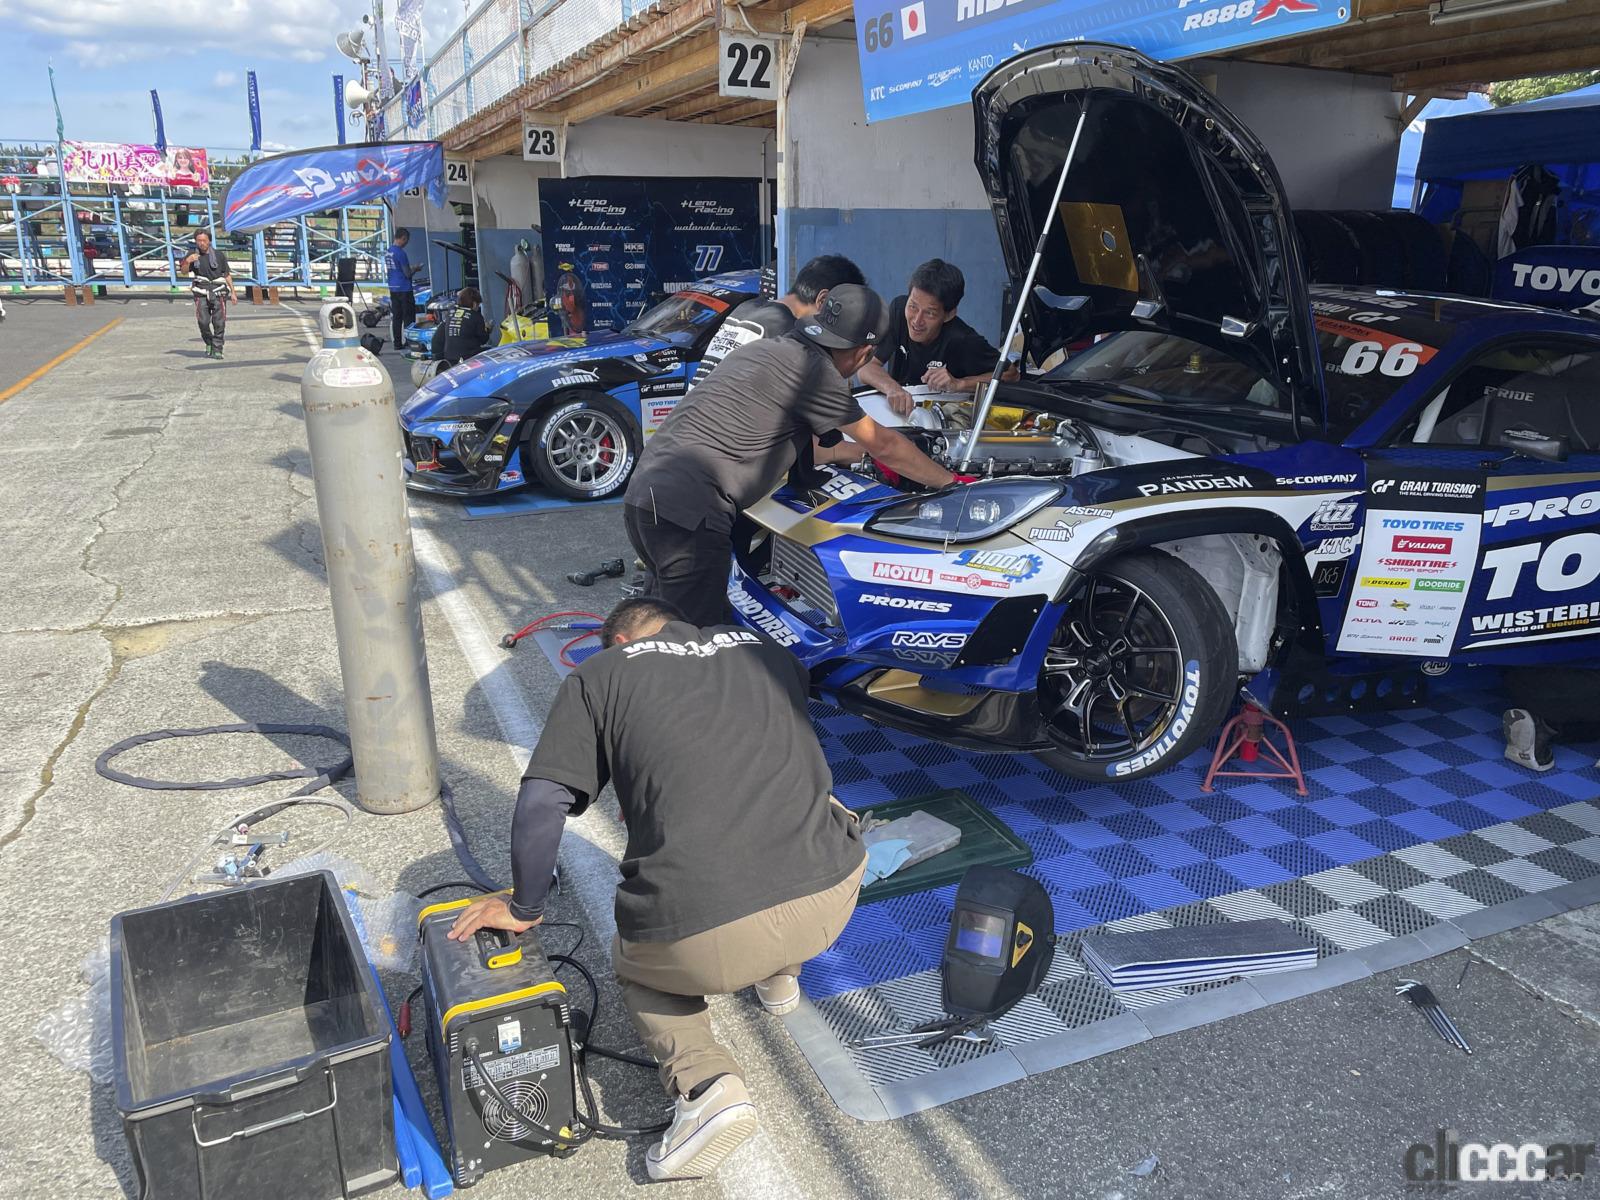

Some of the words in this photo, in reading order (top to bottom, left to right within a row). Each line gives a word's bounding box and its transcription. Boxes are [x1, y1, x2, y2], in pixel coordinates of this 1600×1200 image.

[864, 12, 894, 53] 66
[727, 42, 772, 89] 22
[968, 54, 994, 73] KANTO
[870, 85, 886, 101] KTC
[527, 129, 555, 155] 23
[447, 163, 468, 182] 24
[583, 205, 627, 215] Racing
[694, 206, 735, 216] Racing
[624, 243, 645, 252] HKS
[694, 245, 724, 271] 77
[1512, 262, 1600, 296] TOYO
[1340, 340, 1423, 377] 66
[551, 374, 596, 388] PUMA
[1137, 475, 1254, 497] PANDEM
[1400, 481, 1428, 492] GRAN
[1431, 482, 1477, 494] TURISMO
[1029, 528, 1070, 542] PUMA
[1382, 519, 1420, 529] TOYO
[1422, 520, 1465, 532] TIRES
[1315, 537, 1352, 554] KTC
[1408, 542, 1446, 550] VALINO
[874, 562, 932, 583] MOTUL
[1382, 558, 1450, 569] SHIBATIRE
[1482, 532, 1600, 601] TO
[1418, 580, 1461, 589] GOODRIDE
[858, 594, 953, 613] PROXES
[1471, 601, 1600, 631] WISTERI
[751, 611, 801, 648] TIRES
[1501, 624, 1529, 634] Keep
[1545, 618, 1590, 629] Evolving
[892, 631, 968, 648] RAYS
[1171, 669, 1201, 735] TOYO
[1115, 732, 1177, 777] TIRES
